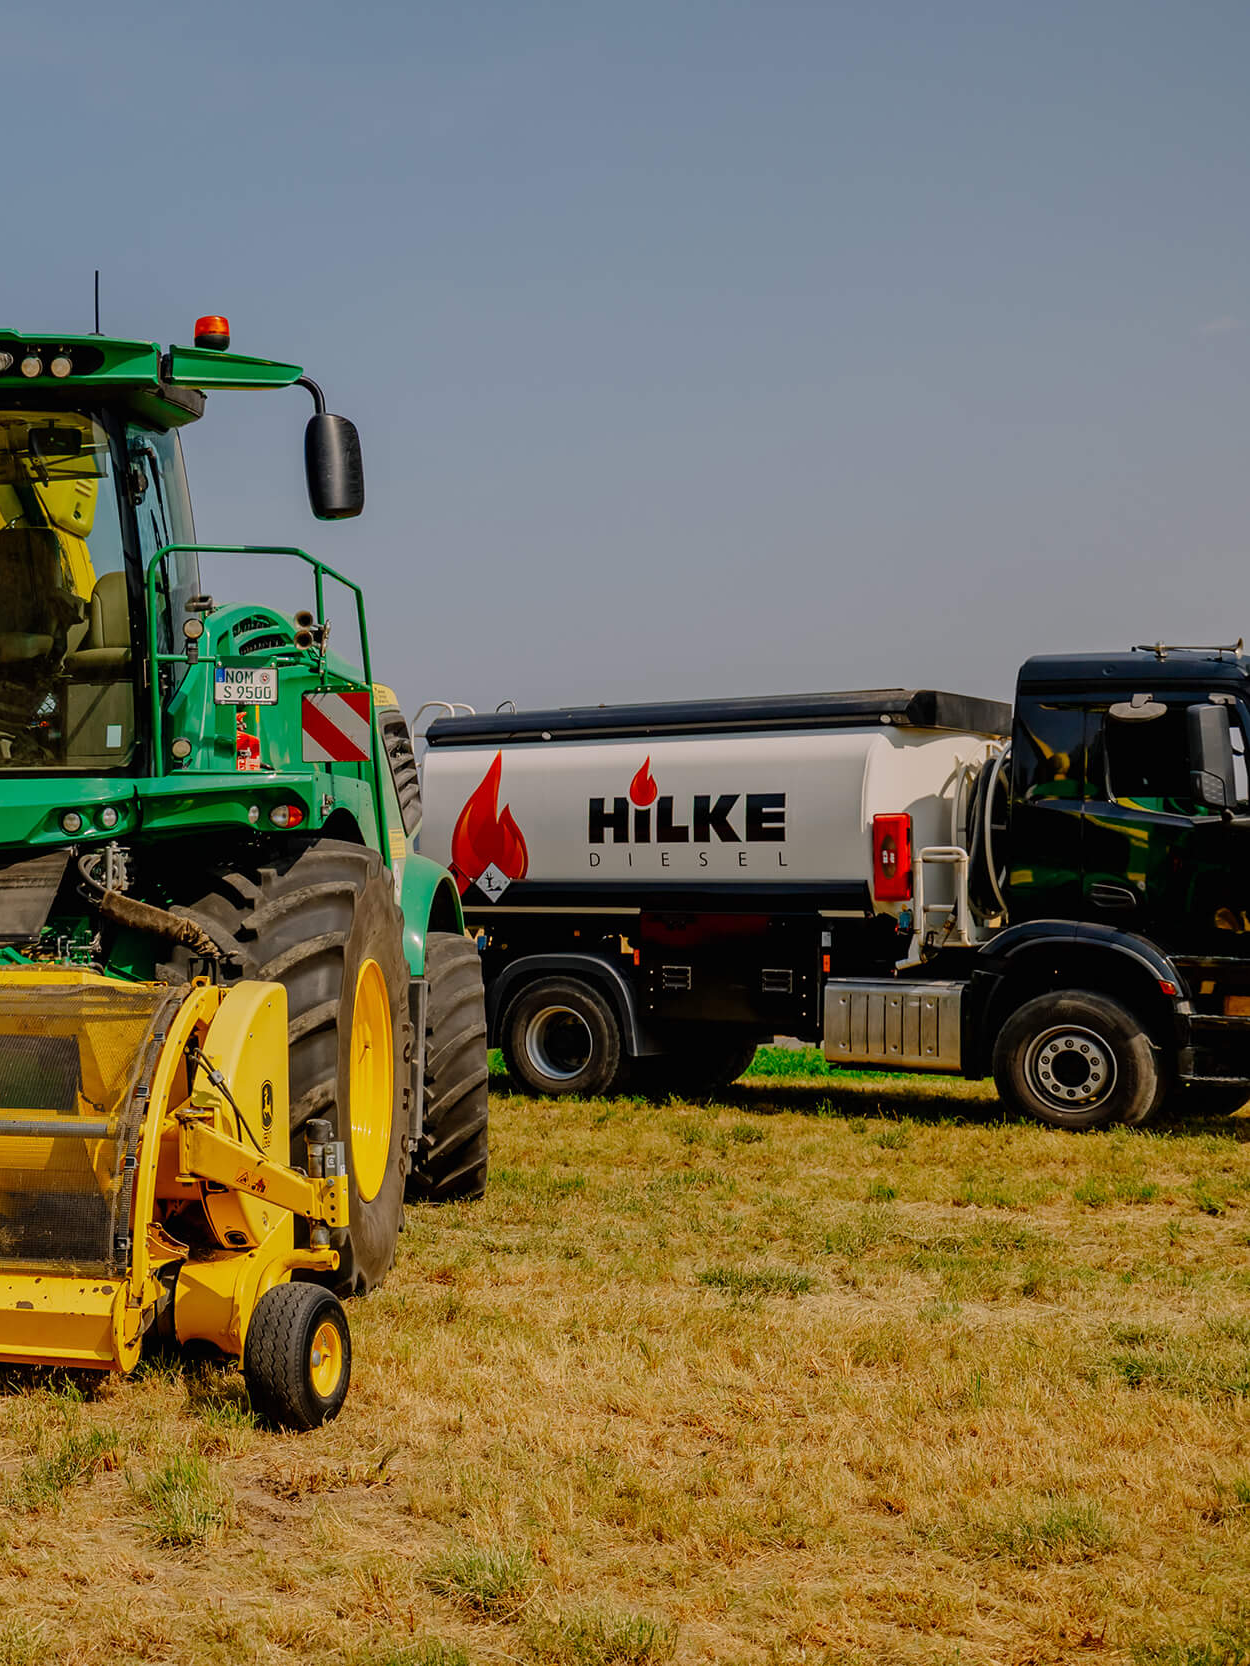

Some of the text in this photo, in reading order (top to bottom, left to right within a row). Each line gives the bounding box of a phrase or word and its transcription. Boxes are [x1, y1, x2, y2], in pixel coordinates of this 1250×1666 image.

[225, 670, 254, 684] NOM
[223, 685, 272, 699] S 9500
[589, 852, 788, 867] DIESEL
